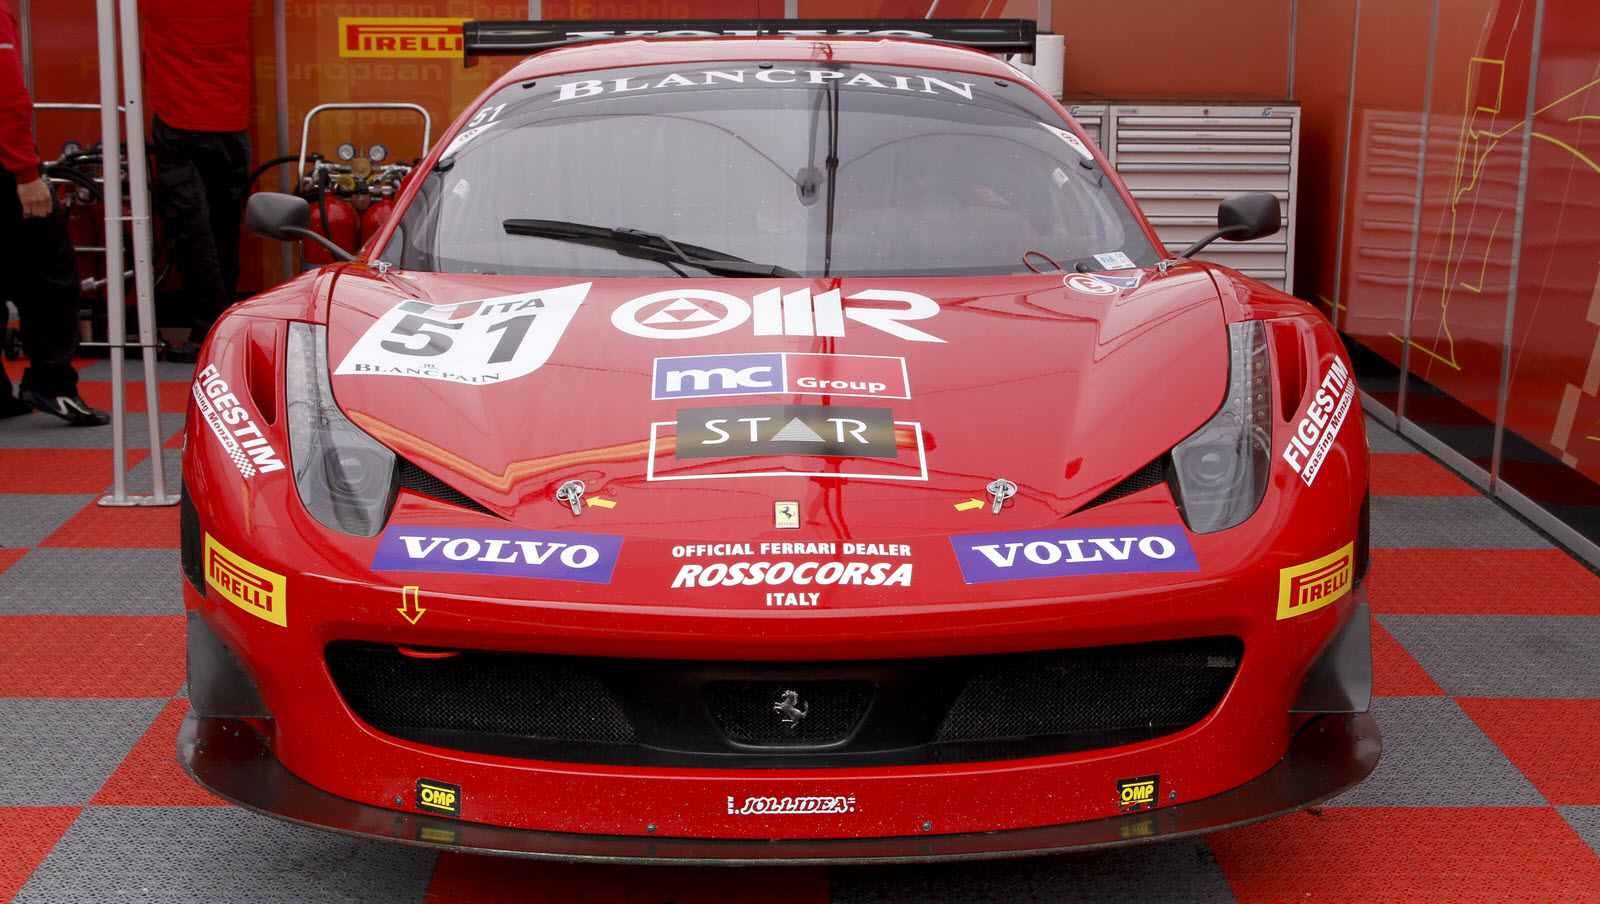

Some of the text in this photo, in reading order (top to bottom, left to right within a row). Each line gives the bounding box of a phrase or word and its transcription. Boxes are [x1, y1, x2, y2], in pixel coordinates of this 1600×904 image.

[346, 24, 463, 51] PIRELLI
[552, 69, 976, 102] BLANCPAIN
[469, 103, 507, 128] 51
[480, 298, 545, 316] ITA
[380, 313, 537, 365] 51
[355, 363, 501, 383] BLANCPAIN
[796, 377, 887, 394] Group
[198, 363, 286, 474] FIGESTIM
[1282, 355, 1349, 474] FIGESTIM
[207, 411, 234, 449] Monza
[1302, 396, 1350, 483] Leasing Monza
[398, 535, 600, 569] VOLVO
[672, 542, 912, 558] OFFICIAL FERRARI DEALER
[971, 535, 1176, 568] VOLVO
[209, 546, 274, 613] PIRELLI
[670, 561, 913, 588] ROSSOCORSA
[1289, 554, 1350, 609] PIRELLI
[766, 592, 820, 606] ITALY
[421, 788, 456, 807] OMP
[1121, 784, 1154, 802] OMP
